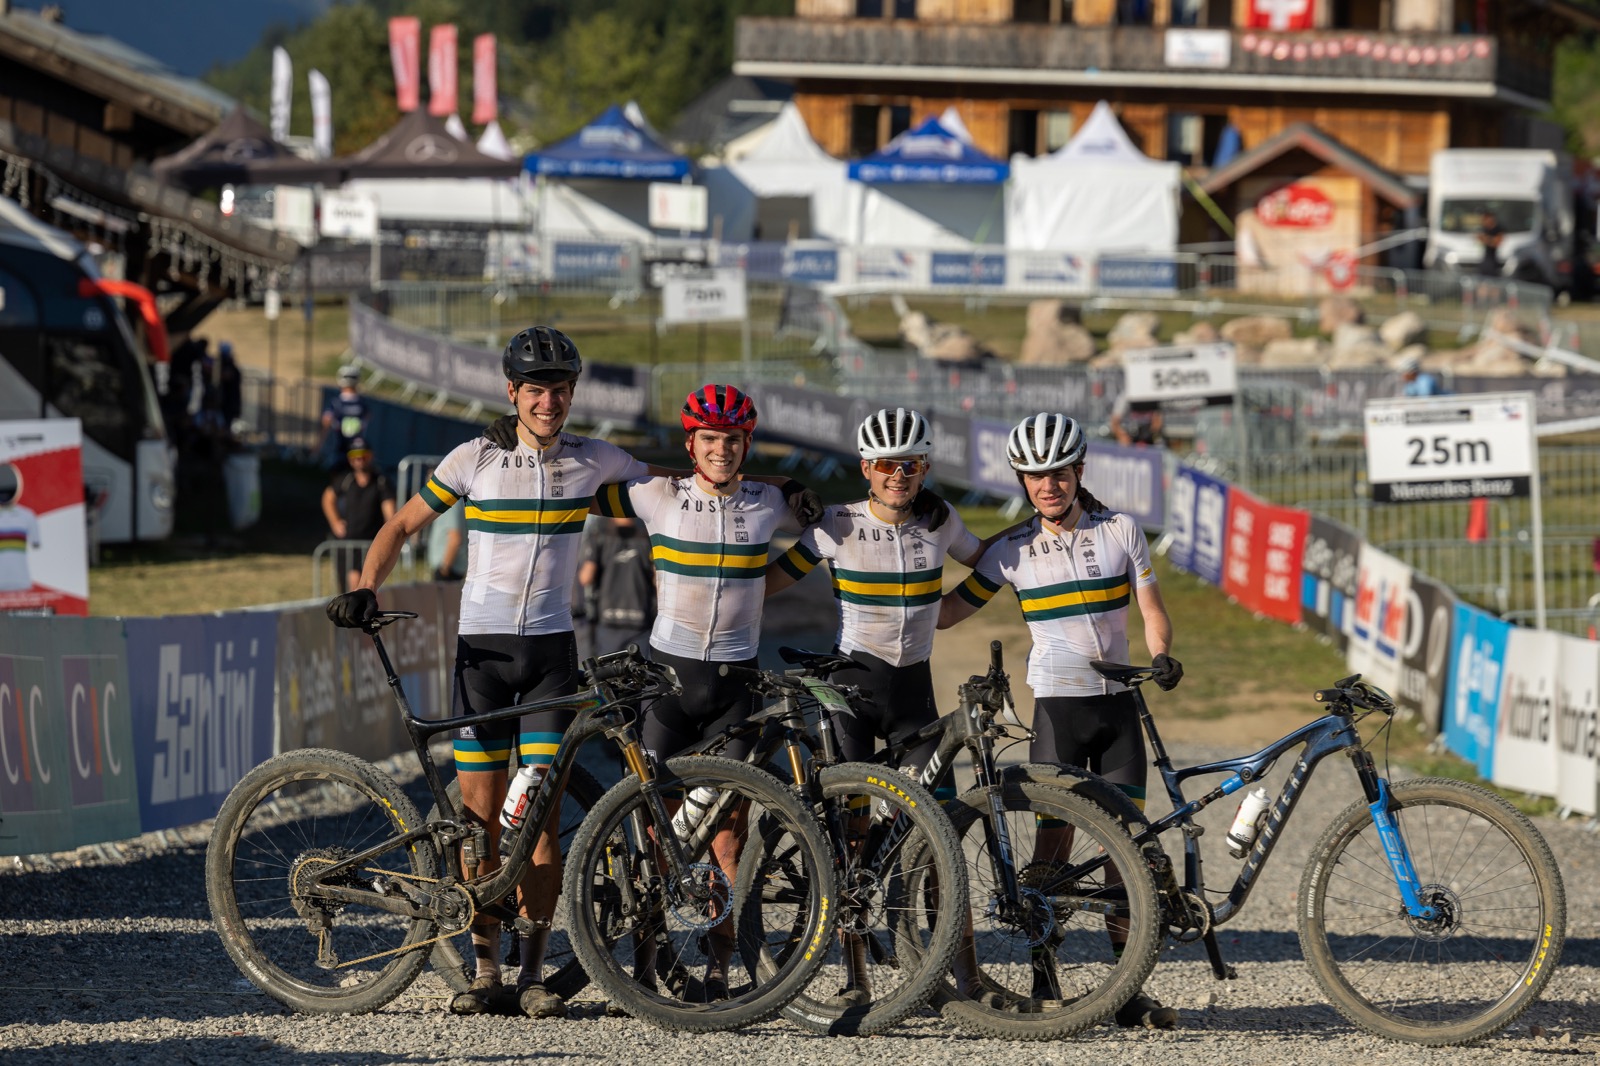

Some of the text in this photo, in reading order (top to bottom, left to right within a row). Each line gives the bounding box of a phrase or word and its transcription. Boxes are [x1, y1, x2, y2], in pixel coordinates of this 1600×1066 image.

[1152, 369, 1210, 391] 50m
[501, 455, 535, 469] AUS
[1407, 436, 1491, 466] 25m
[1390, 479, 1513, 500] Mercedes-Benz
[681, 499, 716, 513] AUS
[1089, 514, 1118, 524] Santini
[858, 528, 895, 542] AUS
[1029, 540, 1063, 557] AUS
[71, 680, 122, 779] CIC
[151, 638, 259, 805] Santini
[0, 681, 51, 785] CIC
[866, 776, 917, 808] MAXXIS
[804, 896, 829, 961] MAXXIS
[1525, 923, 1553, 987] MAXXIS
[806, 1012, 834, 1025] ASPEN
